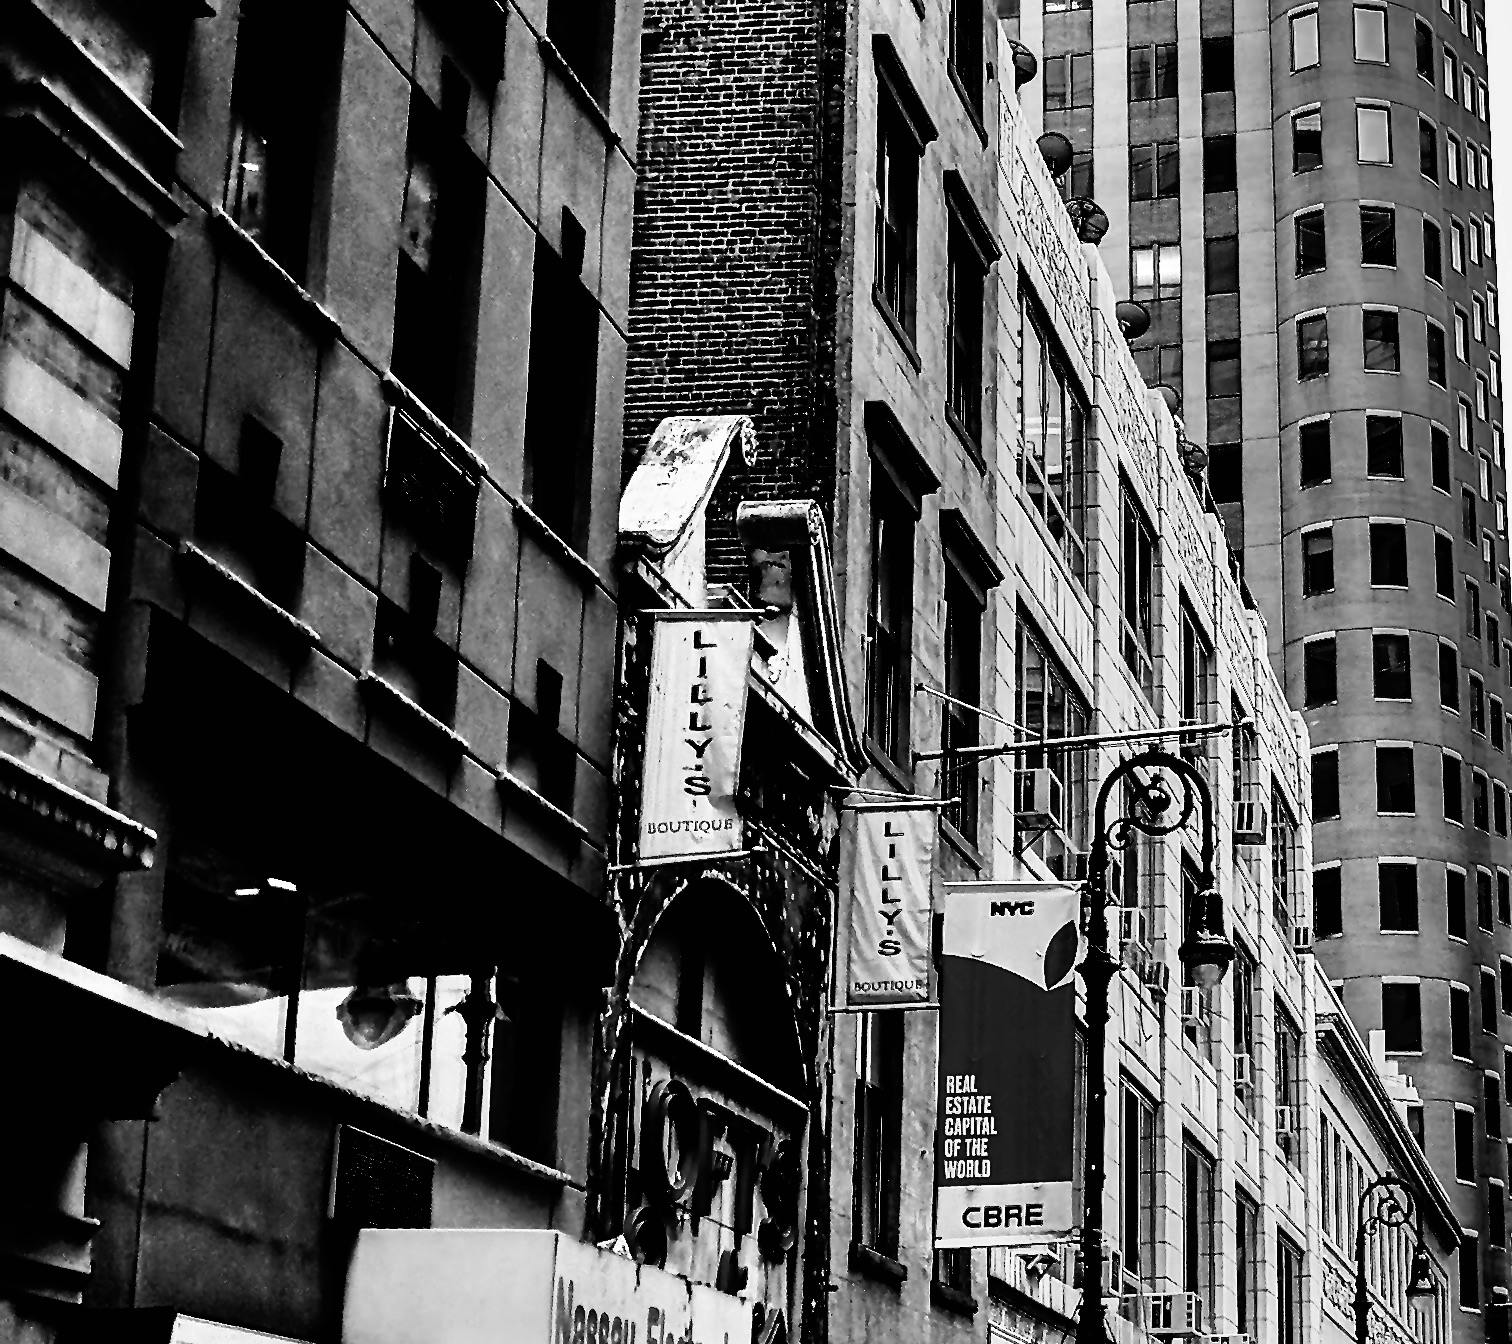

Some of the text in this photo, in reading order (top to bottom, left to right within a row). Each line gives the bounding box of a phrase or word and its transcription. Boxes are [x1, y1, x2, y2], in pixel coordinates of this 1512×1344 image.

[647, 818, 733, 835] BOUTIQUE
[990, 900, 1035, 917] NYC
[854, 979, 924, 993] BOUTIQUE
[946, 1075, 978, 1094] REAL
[945, 1095, 992, 1115] ESTATE
[944, 1116, 998, 1136] CAPITAL
[944, 1137, 989, 1158] OF THE
[944, 1159, 991, 1179] WORLD
[961, 1203, 1044, 1229] CBRE
